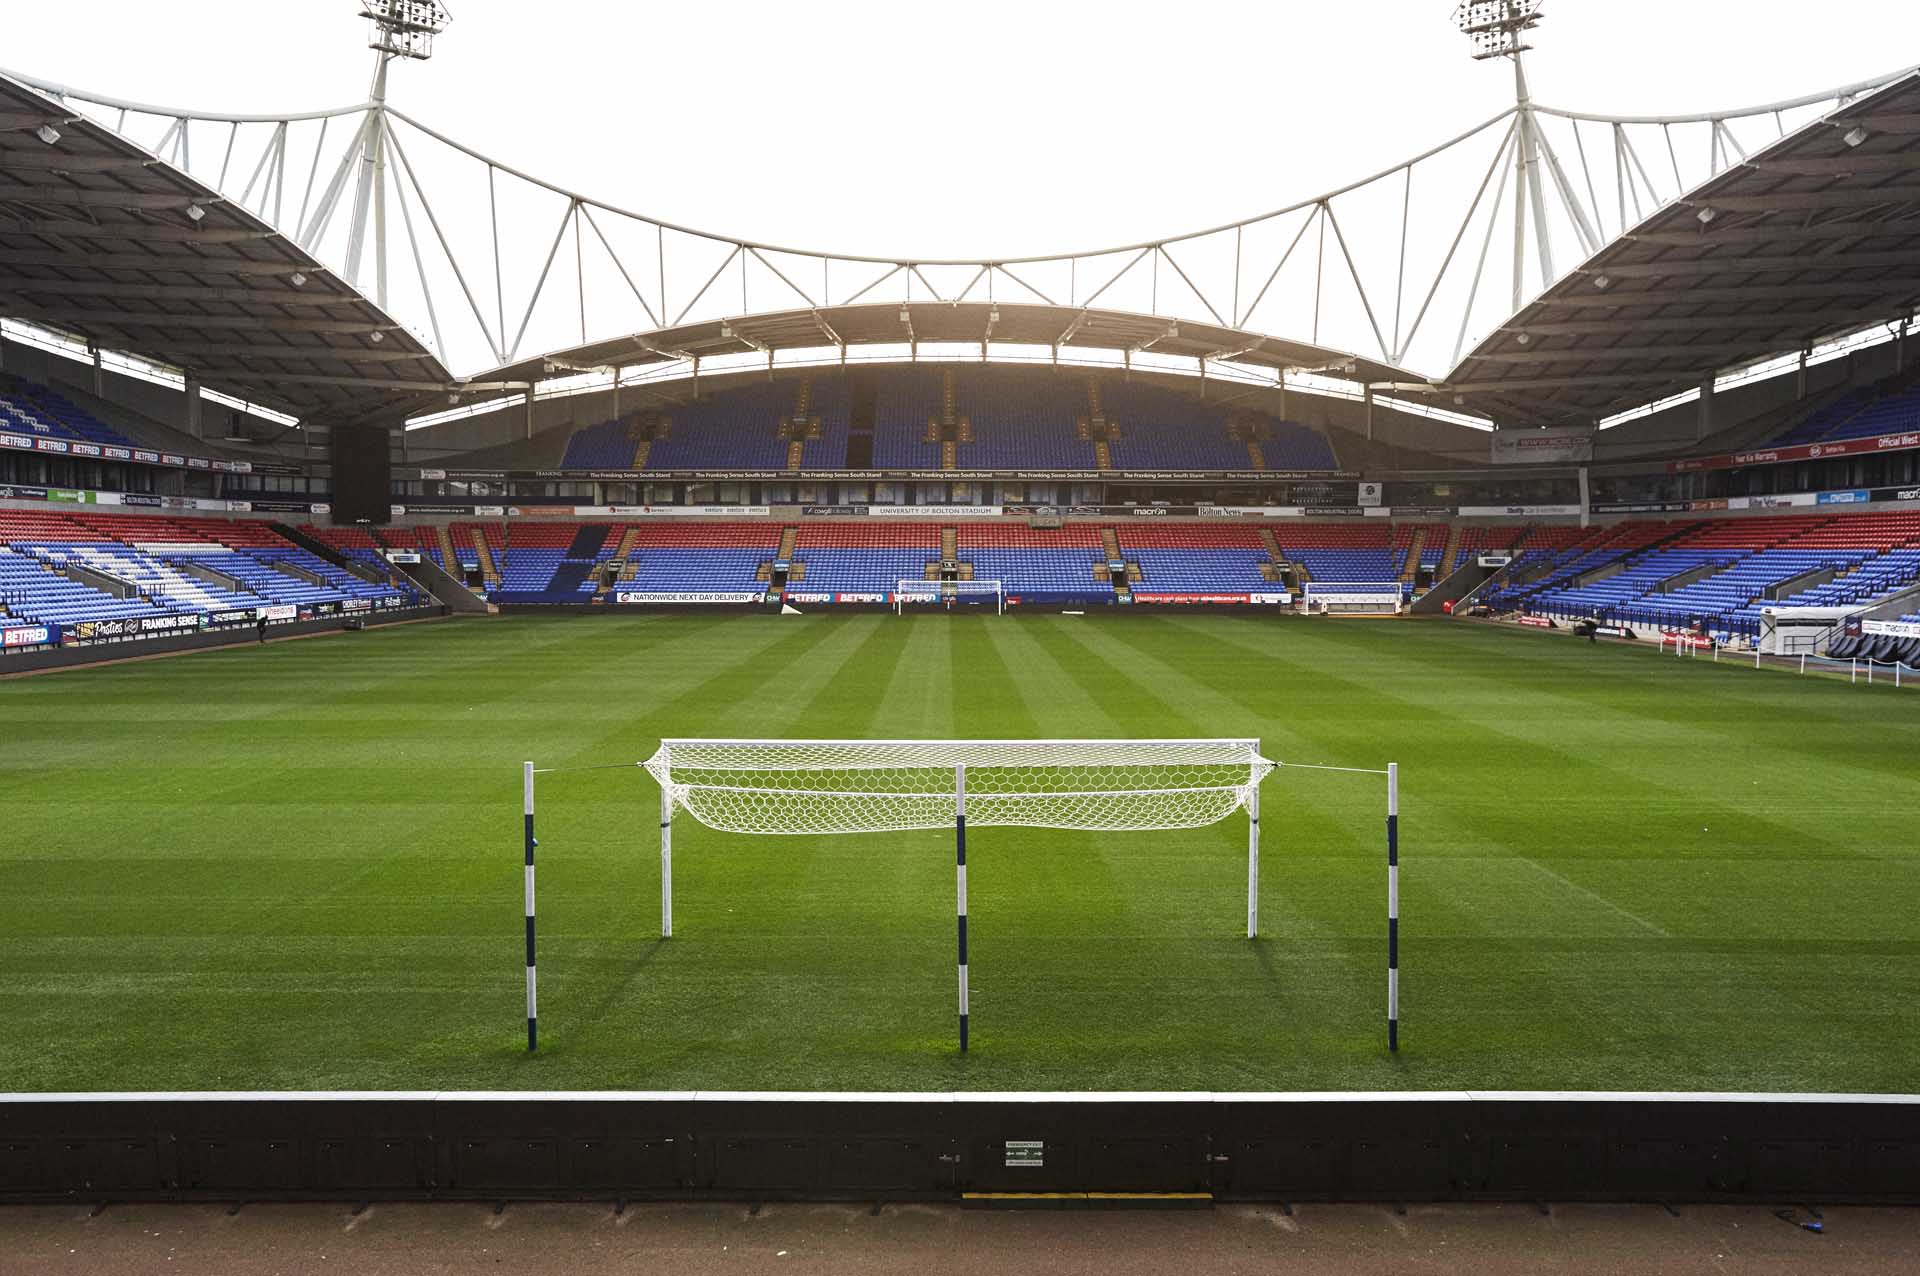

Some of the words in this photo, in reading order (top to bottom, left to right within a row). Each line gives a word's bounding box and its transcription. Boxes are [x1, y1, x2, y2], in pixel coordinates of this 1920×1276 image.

[0, 435, 32, 448] BETFRED
[37, 438, 67, 452] BETFRED
[1878, 436, 1899, 448] Official
[1901, 435, 1918, 446] West
[72, 443, 100, 456] BETFRED
[104, 447, 130, 459] BETFRED
[134, 451, 159, 463] BETFRED
[162, 454, 184, 465] BETFRED
[187, 457, 209, 468] BETFRED
[1133, 507, 1167, 515] macron
[1223, 507, 1241, 515] News
[141, 616, 177, 630] FRANKING
[177, 615, 198, 626] SENSE
[5, 628, 48, 644] BETFRED
